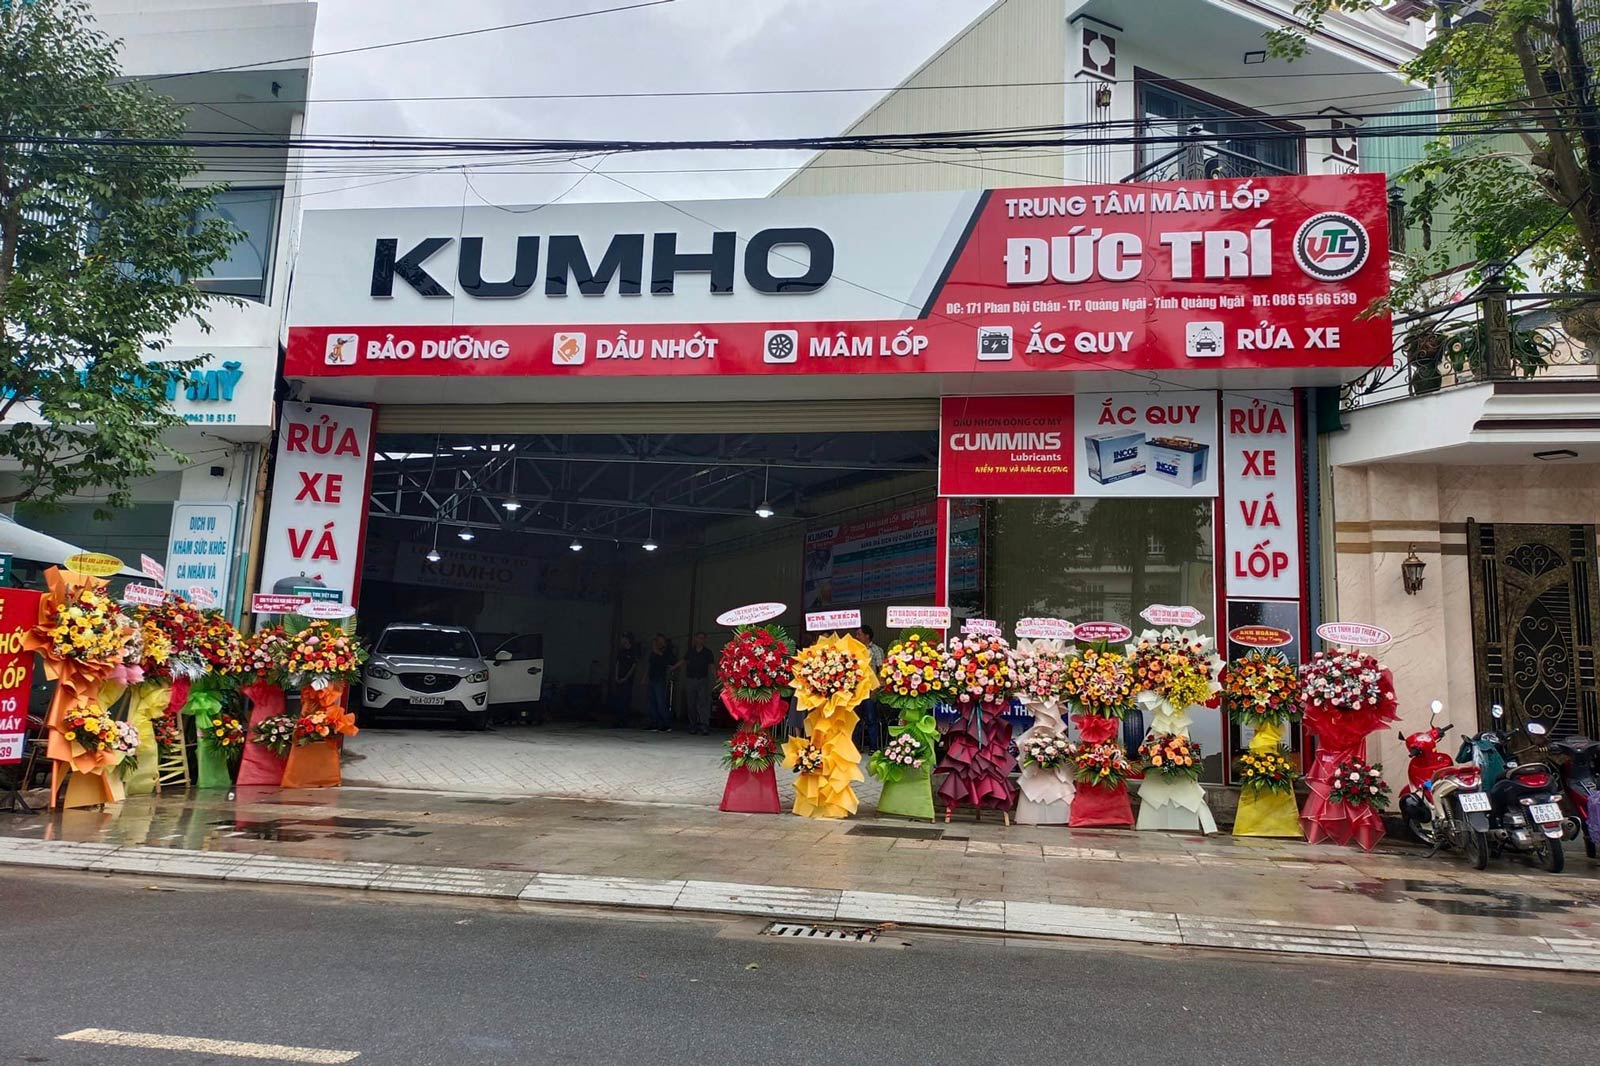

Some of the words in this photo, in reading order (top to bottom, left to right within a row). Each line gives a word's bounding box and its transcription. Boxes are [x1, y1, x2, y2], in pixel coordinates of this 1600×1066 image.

[1005, 196, 1087, 218] TRUNG
[1094, 190, 1146, 215] TÂM
[1150, 187, 1218, 213] MÂM
[1220, 180, 1270, 210] LỐP
[370, 227, 834, 299] KUMHO
[1003, 224, 1143, 286] ĐỨC
[1160, 218, 1274, 280] TRÍ
[946, 303, 964, 314] ĐC:
[966, 303, 982, 314] 171
[984, 303, 1010, 314] Phan
[1012, 301, 1030, 315] Bội
[1033, 300, 1061, 313] Châu
[1085, 298, 1119, 313] Quảng
[1122, 298, 1146, 313] Ngãi
[1181, 295, 1217, 310] Quảng
[1219, 295, 1245, 309] Ngãi
[1253, 295, 1271, 307] ĐT:
[1272, 293, 1296, 307] 086
[1298, 293, 1315, 306] 55
[1315, 293, 1332, 306] 66
[1333, 292, 1357, 305] 539
[366, 334, 416, 360] BẢO
[421, 335, 510, 360] DƯỠNG
[596, 330, 645, 359] DẦU
[651, 331, 718, 359] NHỚT
[809, 331, 873, 357] MÂM
[879, 326, 929, 356] LỐP
[1025, 321, 1066, 354] ẮC
[1074, 331, 1134, 354] QUY
[1237, 319, 1294, 350] RỬA
[1304, 327, 1341, 349] XE
[1098, 397, 1136, 425] ẮC
[1145, 406, 1200, 424] QUY
[1230, 398, 1287, 434] RỬA
[286, 414, 360, 457] RỬA
[950, 432, 1061, 451] CUMMINS
[1011, 453, 1062, 462] Lubricants
[1113, 446, 1138, 459] INCOE
[1156, 461, 1179, 472] INCOE
[1241, 450, 1276, 476] XE
[295, 471, 344, 504] XE
[1239, 492, 1280, 527] VÁ
[287, 521, 339, 561] VÁ
[807, 530, 833, 543] KUMHO
[1235, 539, 1289, 578] LỐP
